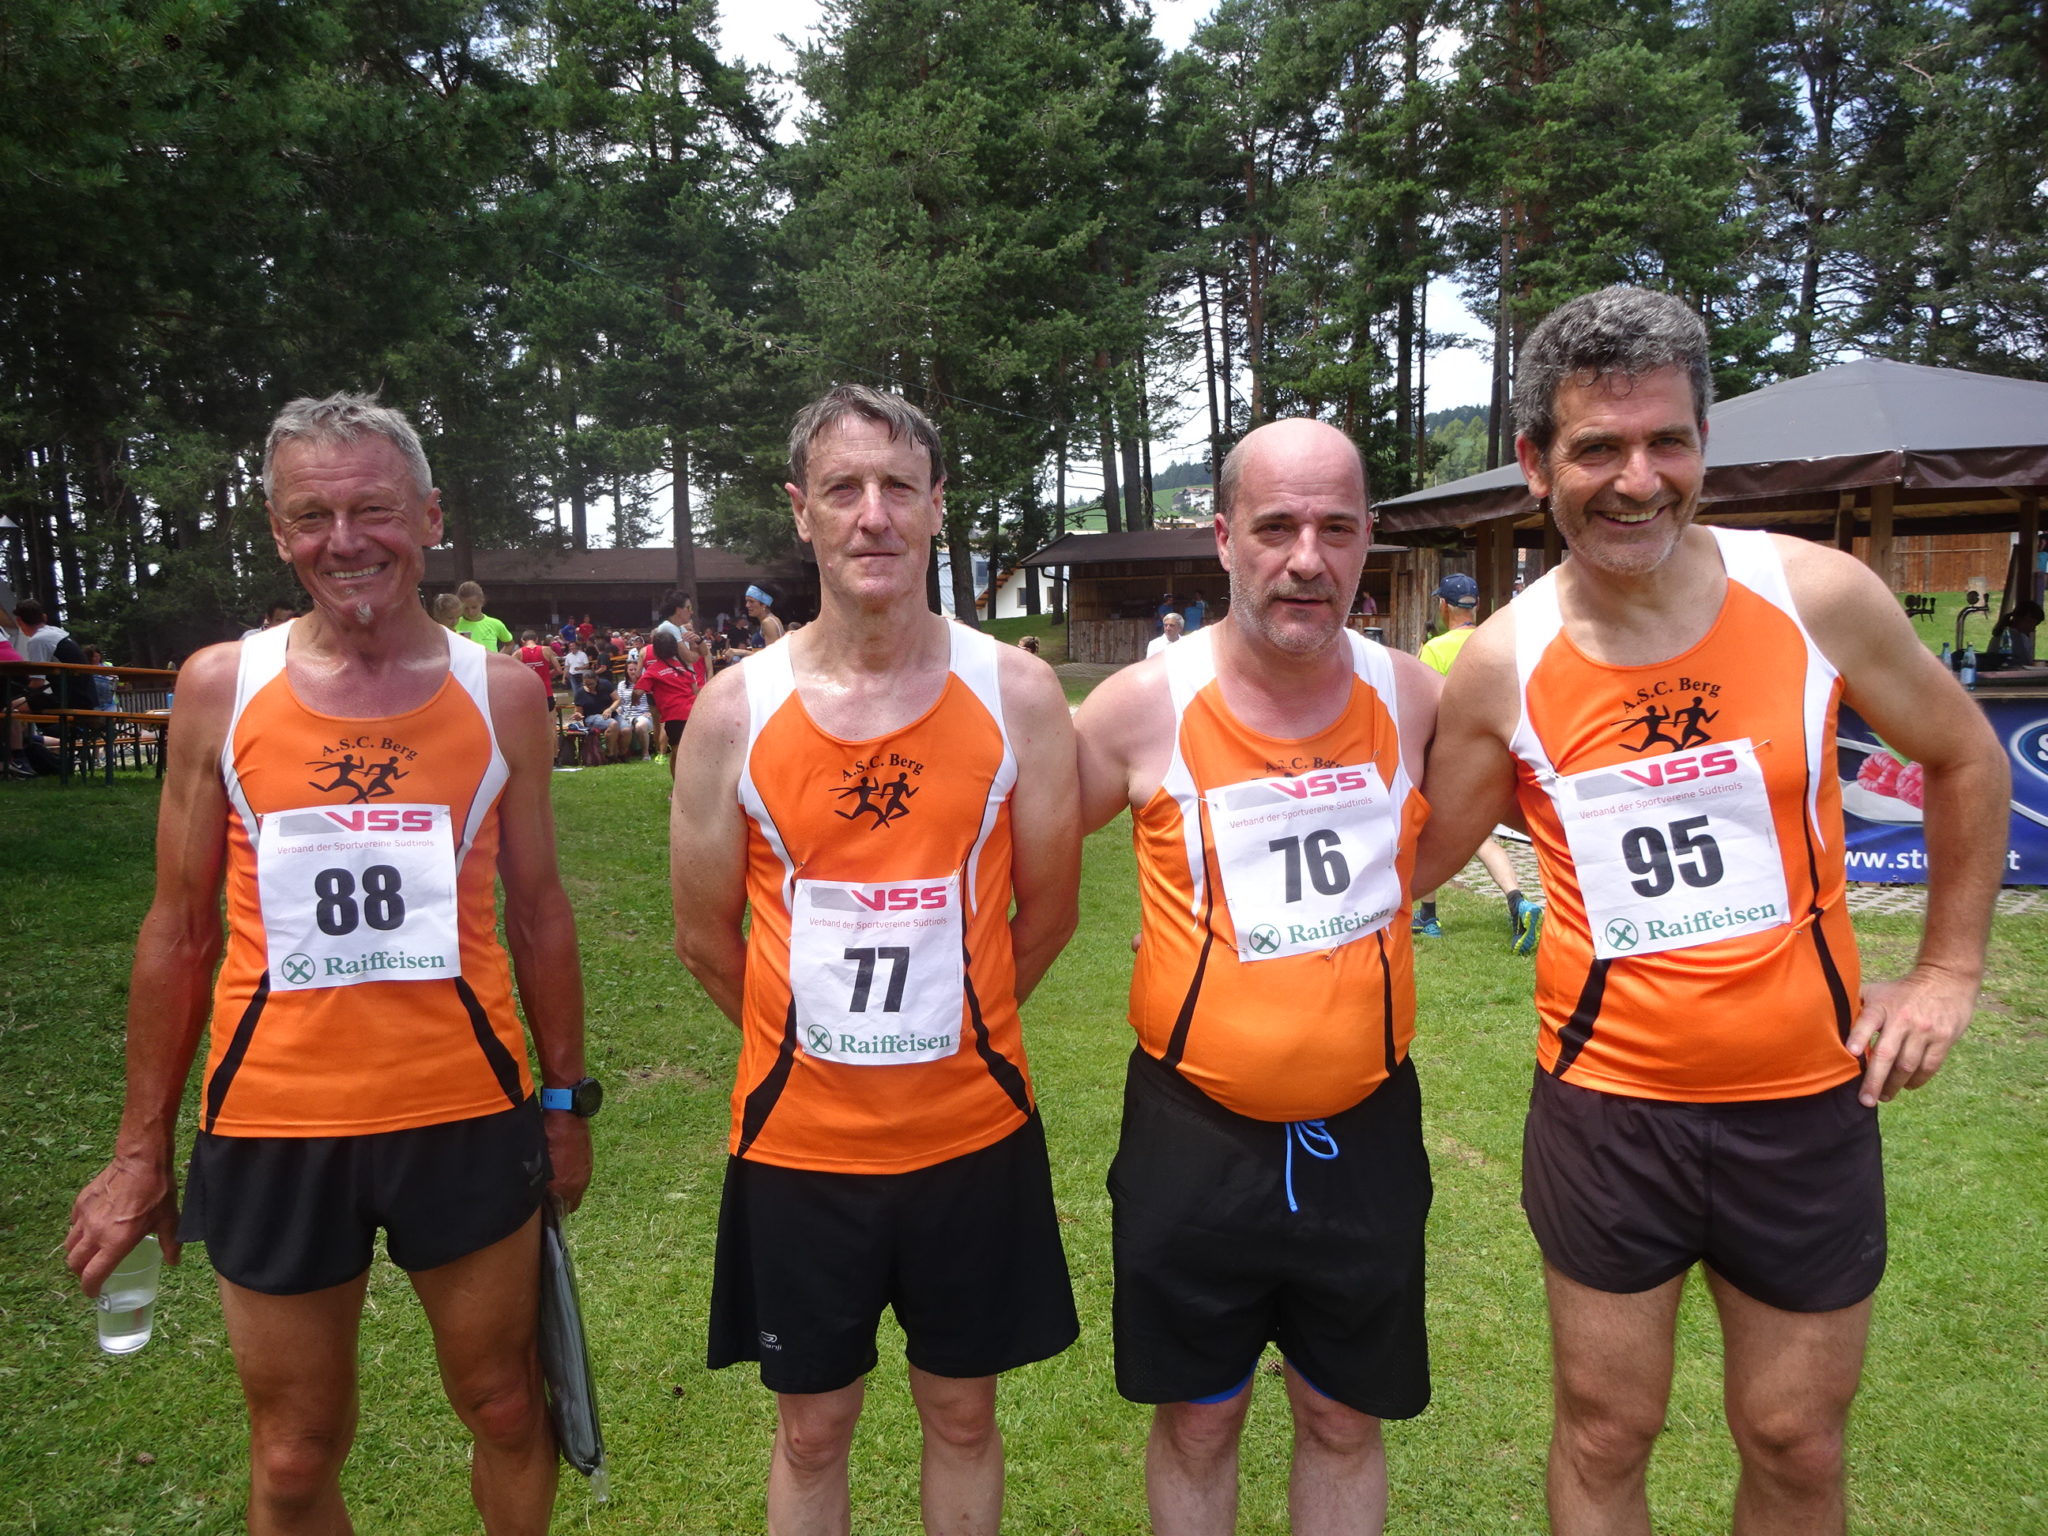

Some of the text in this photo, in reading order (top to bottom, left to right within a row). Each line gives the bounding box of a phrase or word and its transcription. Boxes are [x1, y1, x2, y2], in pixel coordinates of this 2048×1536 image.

[1622, 677, 1721, 713] A.S.C. Berg
[322, 736, 419, 761] A.S.C. Berg
[842, 753, 924, 782] A.S.C. Berg
[1620, 750, 1738, 787] VSS
[1269, 771, 1367, 800] VSS
[1229, 816, 1265, 829] Verband
[1267, 813, 1281, 823] der
[1282, 805, 1335, 820] Sportvereine
[1579, 806, 1616, 819] Verband
[1618, 801, 1633, 812] der
[1635, 790, 1696, 809] Sportvereine
[325, 810, 433, 832] VSS
[277, 843, 314, 855] Verband
[317, 842, 332, 852] der
[334, 840, 392, 851] Sportvereine
[1621, 814, 1724, 898] 95
[1268, 828, 1351, 904] 76
[314, 864, 406, 936] 88
[851, 886, 948, 911] VSS
[809, 917, 841, 928] Verband
[842, 920, 855, 930] der
[856, 919, 911, 931] Sportvereine
[1287, 908, 1390, 945] Raiffeisen
[1645, 903, 1777, 941] Raiffeisen
[323, 951, 446, 977] Raiffeisen
[843, 946, 910, 1013] 77
[839, 1032, 951, 1055] Raiffeisen
